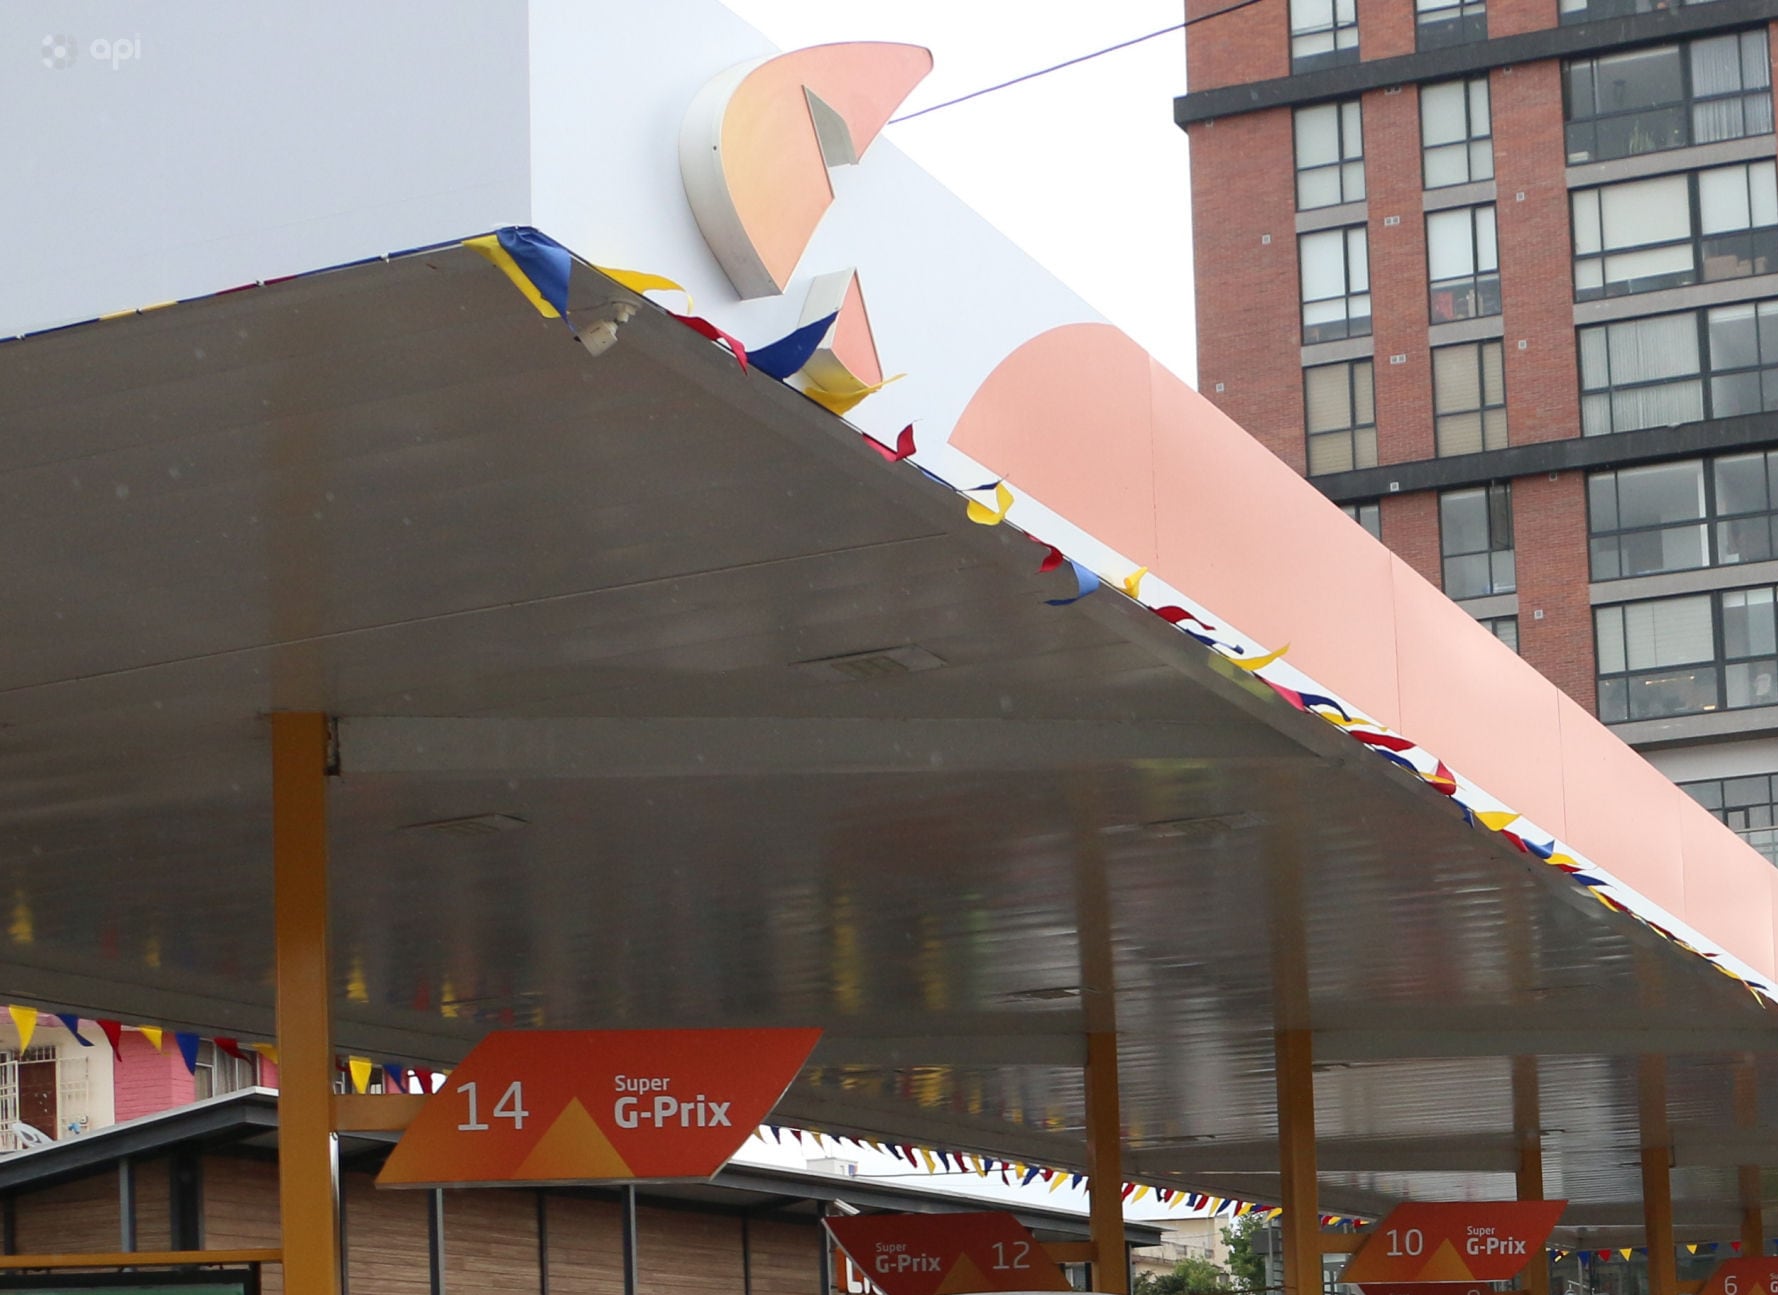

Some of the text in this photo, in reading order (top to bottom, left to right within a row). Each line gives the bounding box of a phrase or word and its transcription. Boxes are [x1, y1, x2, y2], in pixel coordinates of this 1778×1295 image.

[614, 1074, 671, 1096] Super
[456, 1081, 732, 1131] 14 G-Prix
[1386, 1226, 1495, 1256] 10 Super
[1466, 1237, 1526, 1255] G-Prix
[875, 1241, 1030, 1270] Super 12
[875, 1253, 941, 1273] G-Prix
